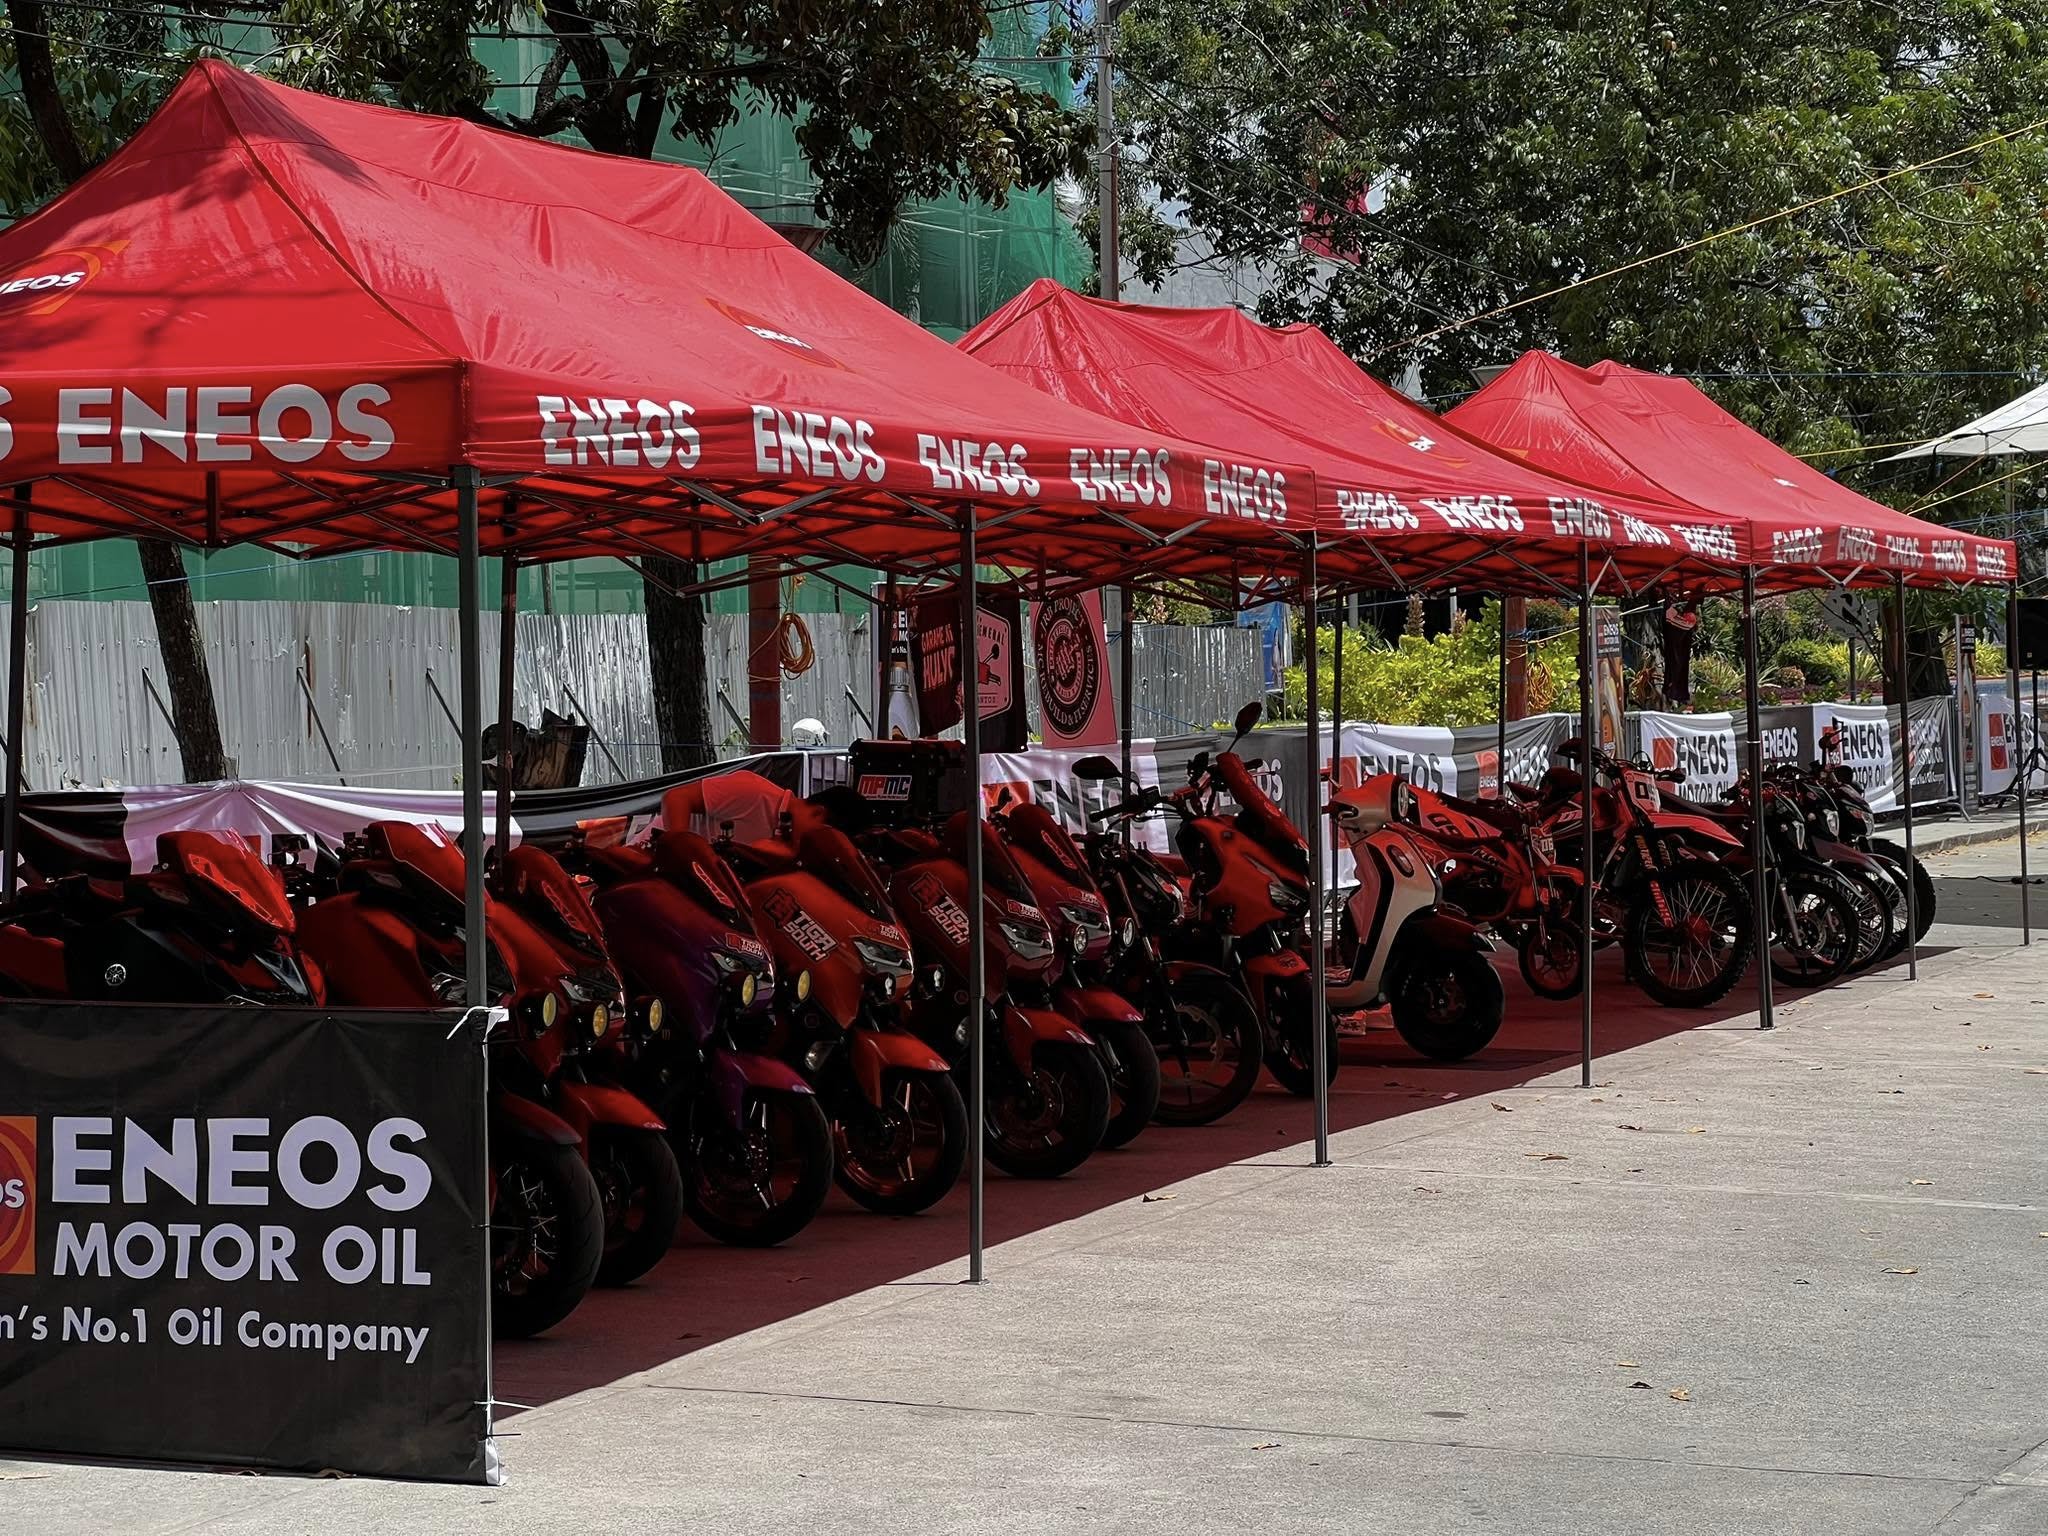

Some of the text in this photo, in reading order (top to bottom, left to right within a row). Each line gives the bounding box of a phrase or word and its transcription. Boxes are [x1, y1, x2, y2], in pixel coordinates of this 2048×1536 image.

[57, 383, 395, 465] ENEOS
[536, 395, 1287, 523] ENEOS ENEOS ENEOS ENEOS ENEOS
[1419, 495, 1524, 532] ENEOS
[1547, 497, 1611, 539] ENEOS
[1676, 733, 1729, 776] ENEOS
[1761, 726, 1798, 760] ENEOS
[1841, 723, 1884, 760] ENEOS
[783, 921, 826, 961] SOUTH
[52, 1115, 432, 1212] ENEOS
[53, 1221, 431, 1285] MOTOR OIL
[62, 1306, 147, 1343] No.1
[168, 1306, 222, 1346] Oil
[237, 1311, 429, 1364] Company
